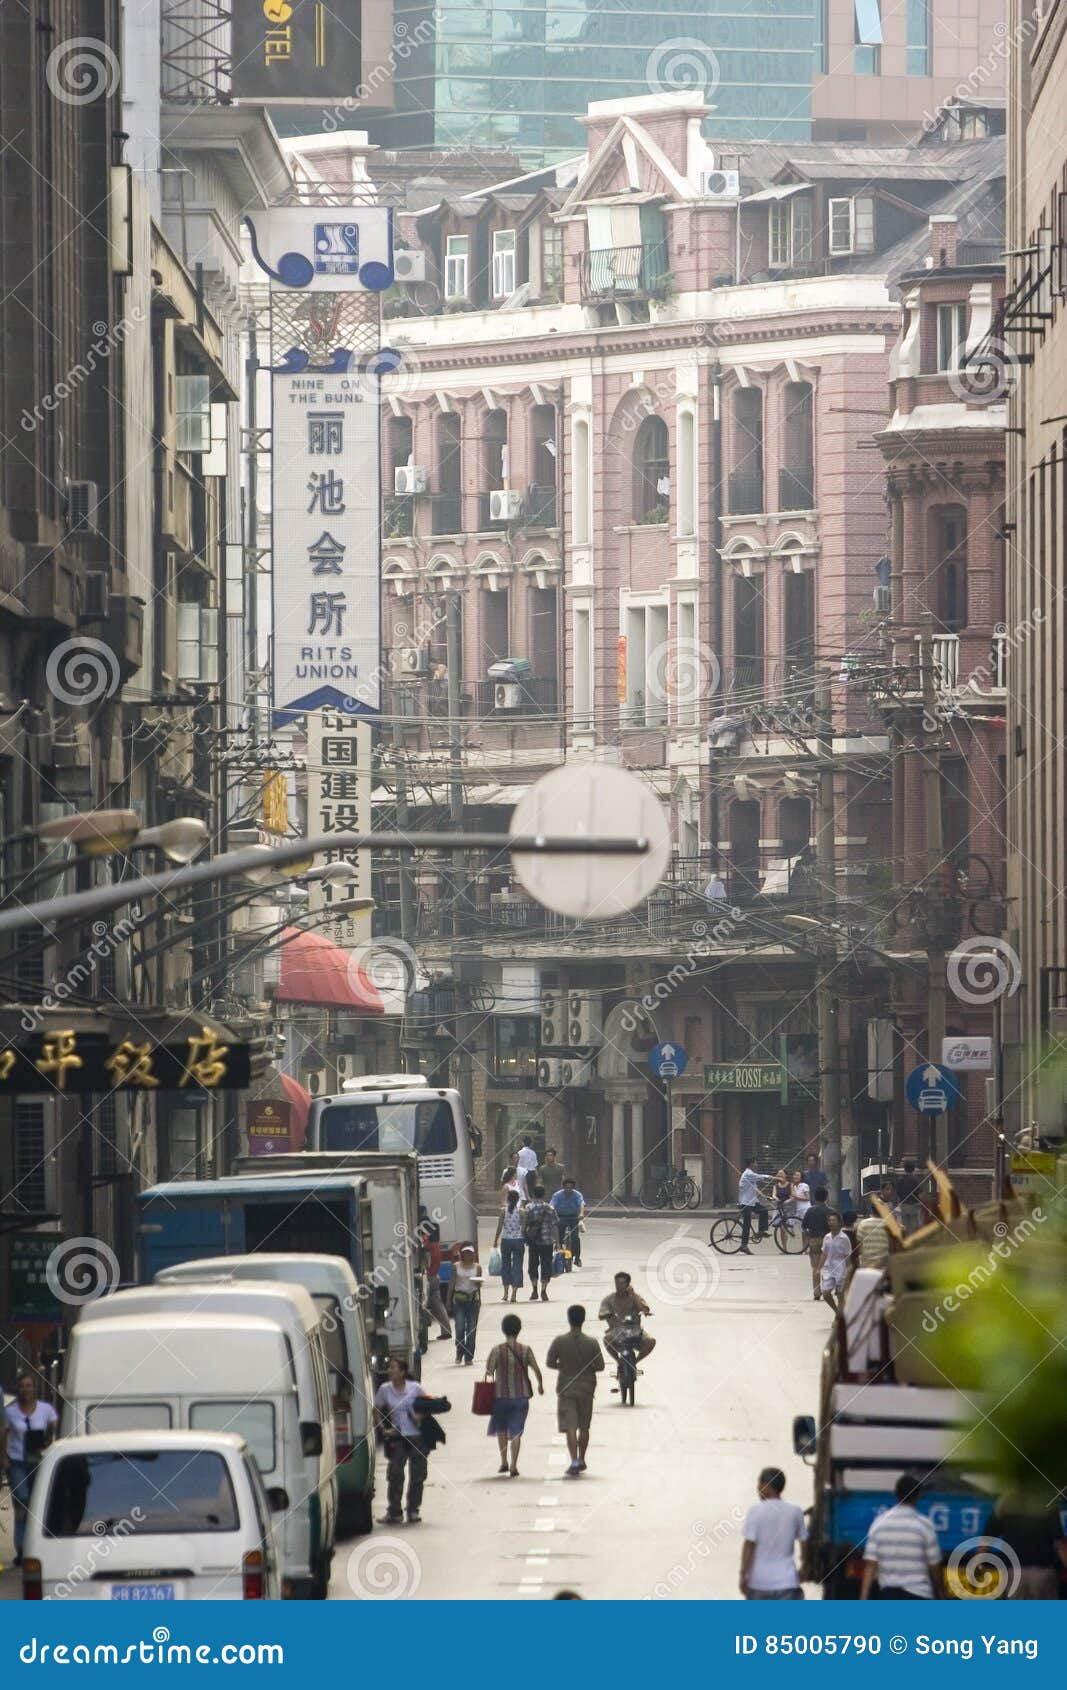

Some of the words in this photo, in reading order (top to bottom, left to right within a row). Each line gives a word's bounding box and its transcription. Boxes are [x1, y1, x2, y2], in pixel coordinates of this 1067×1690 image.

[291, 379, 325, 390] NINE
[340, 379, 360, 390] ON
[289, 393, 317, 403] THE
[324, 393, 364, 403] BUND
[306, 410, 347, 637] 丽池会所
[301, 646, 352, 660] RITS
[295, 664, 359, 679] UNION
[735, 1068, 762, 1088] ROSSI
